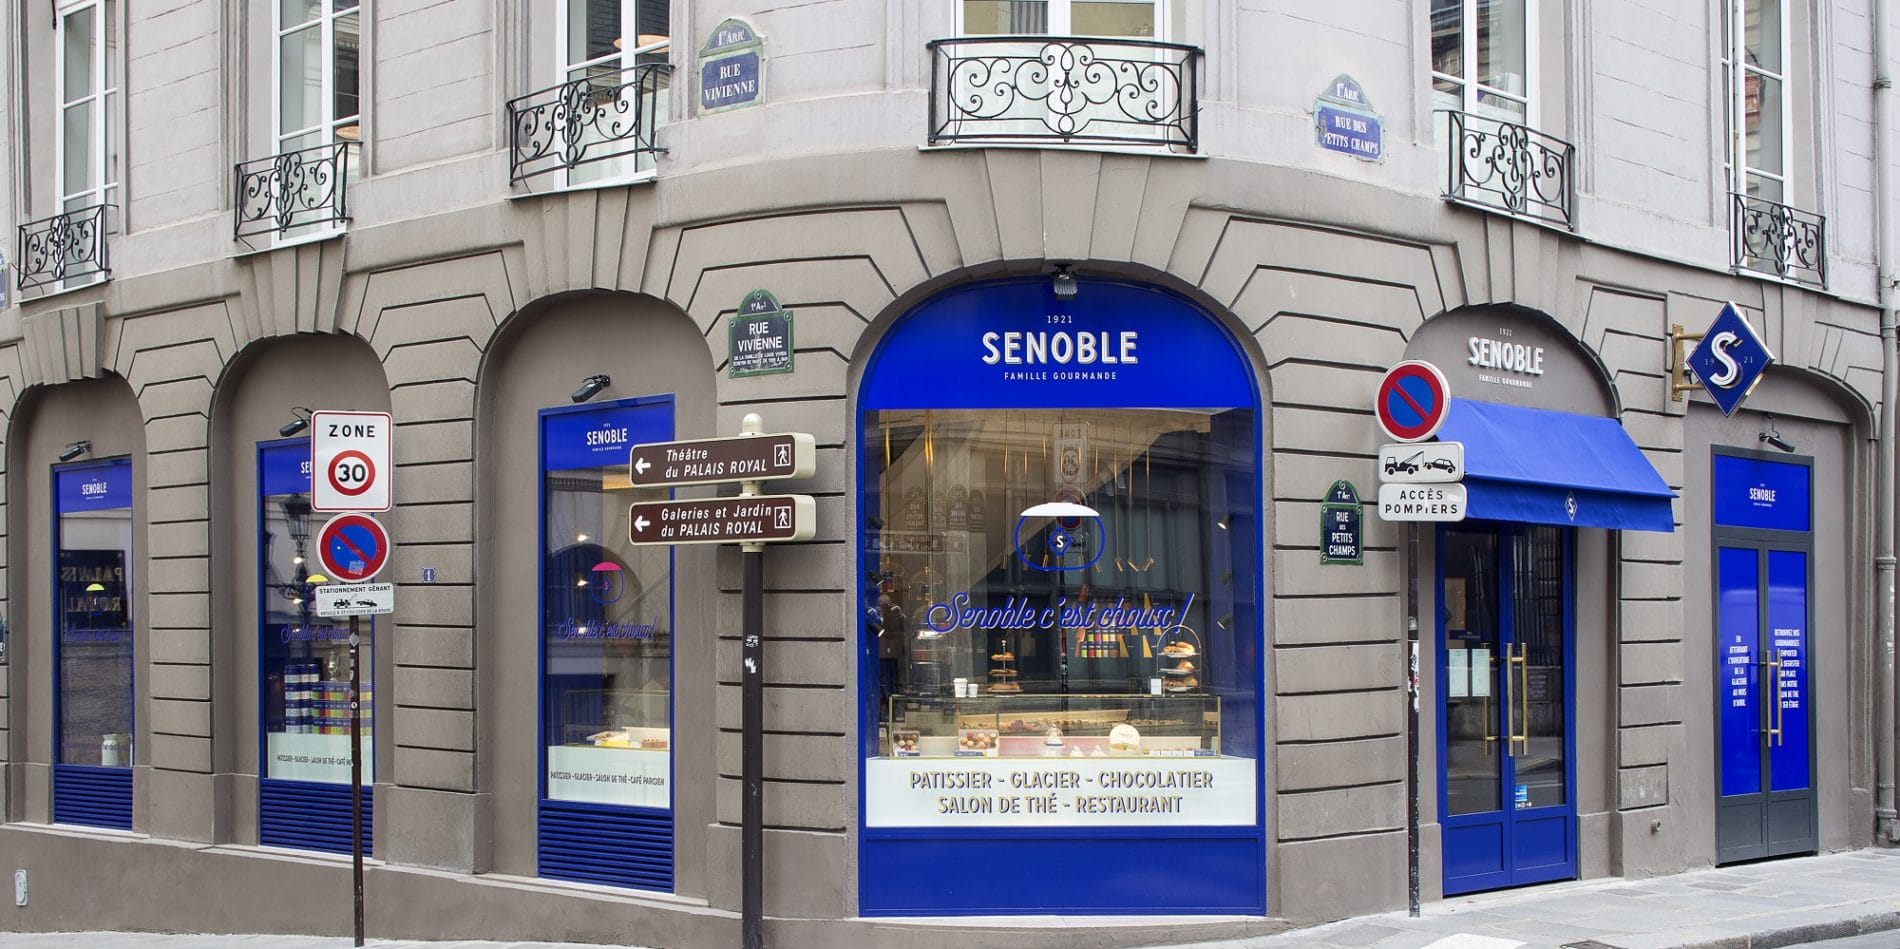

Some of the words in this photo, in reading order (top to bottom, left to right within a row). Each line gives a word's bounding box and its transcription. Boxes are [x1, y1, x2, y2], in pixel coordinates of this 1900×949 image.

[720, 64, 740, 80] RUE
[704, 80, 755, 101] VIVIENNE
[1335, 116, 1351, 130] RUE
[1354, 120, 1366, 133] DES
[1351, 138, 1378, 154] CHAMPS
[1047, 315, 1072, 323] 1921
[749, 322, 769, 335] RUE
[1499, 328, 1512, 336] 1921
[738, 336, 782, 352] VIVIENNE
[982, 332, 1138, 365] SENOBLE
[1468, 336, 1544, 375] SENOBLE
[1004, 372, 1047, 380] FAMILLE
[1053, 372, 1117, 380] GOURMANDE
[1479, 374, 1500, 384] FAMILLE
[329, 425, 375, 438] ZONE
[587, 428, 627, 445] SENOBLE
[666, 448, 708, 462] Théâtre
[338, 464, 366, 482] 30
[666, 467, 678, 478] du
[684, 462, 724, 477] PALAIS
[730, 459, 767, 474] ROYAL
[82, 482, 107, 495] SENOBLE
[1400, 488, 1443, 500] ACCÈS
[1750, 487, 1776, 502] SENOBLE
[662, 507, 709, 520] Galeries
[715, 507, 727, 518] et
[734, 504, 772, 517] Jardin
[1336, 512, 1349, 522] RUE
[1385, 504, 1458, 514] POMPIERS
[662, 525, 674, 537] du
[680, 522, 720, 536] PALAIS
[726, 521, 763, 534] ROYAL
[1332, 532, 1353, 543] PETITS
[1329, 545, 1356, 556] CHAMPS
[926, 592, 1036, 634] Senoble
[1039, 596, 1096, 628] c'est
[910, 771, 992, 789] PATISSIER
[1010, 771, 1080, 789] GLACIER
[1100, 770, 1213, 789] CHOCOLATIER
[938, 795, 992, 814] SALON
[999, 795, 1020, 814] DE
[1025, 792, 1058, 814] THÉ
[1076, 795, 1183, 813] RESTAURANT
